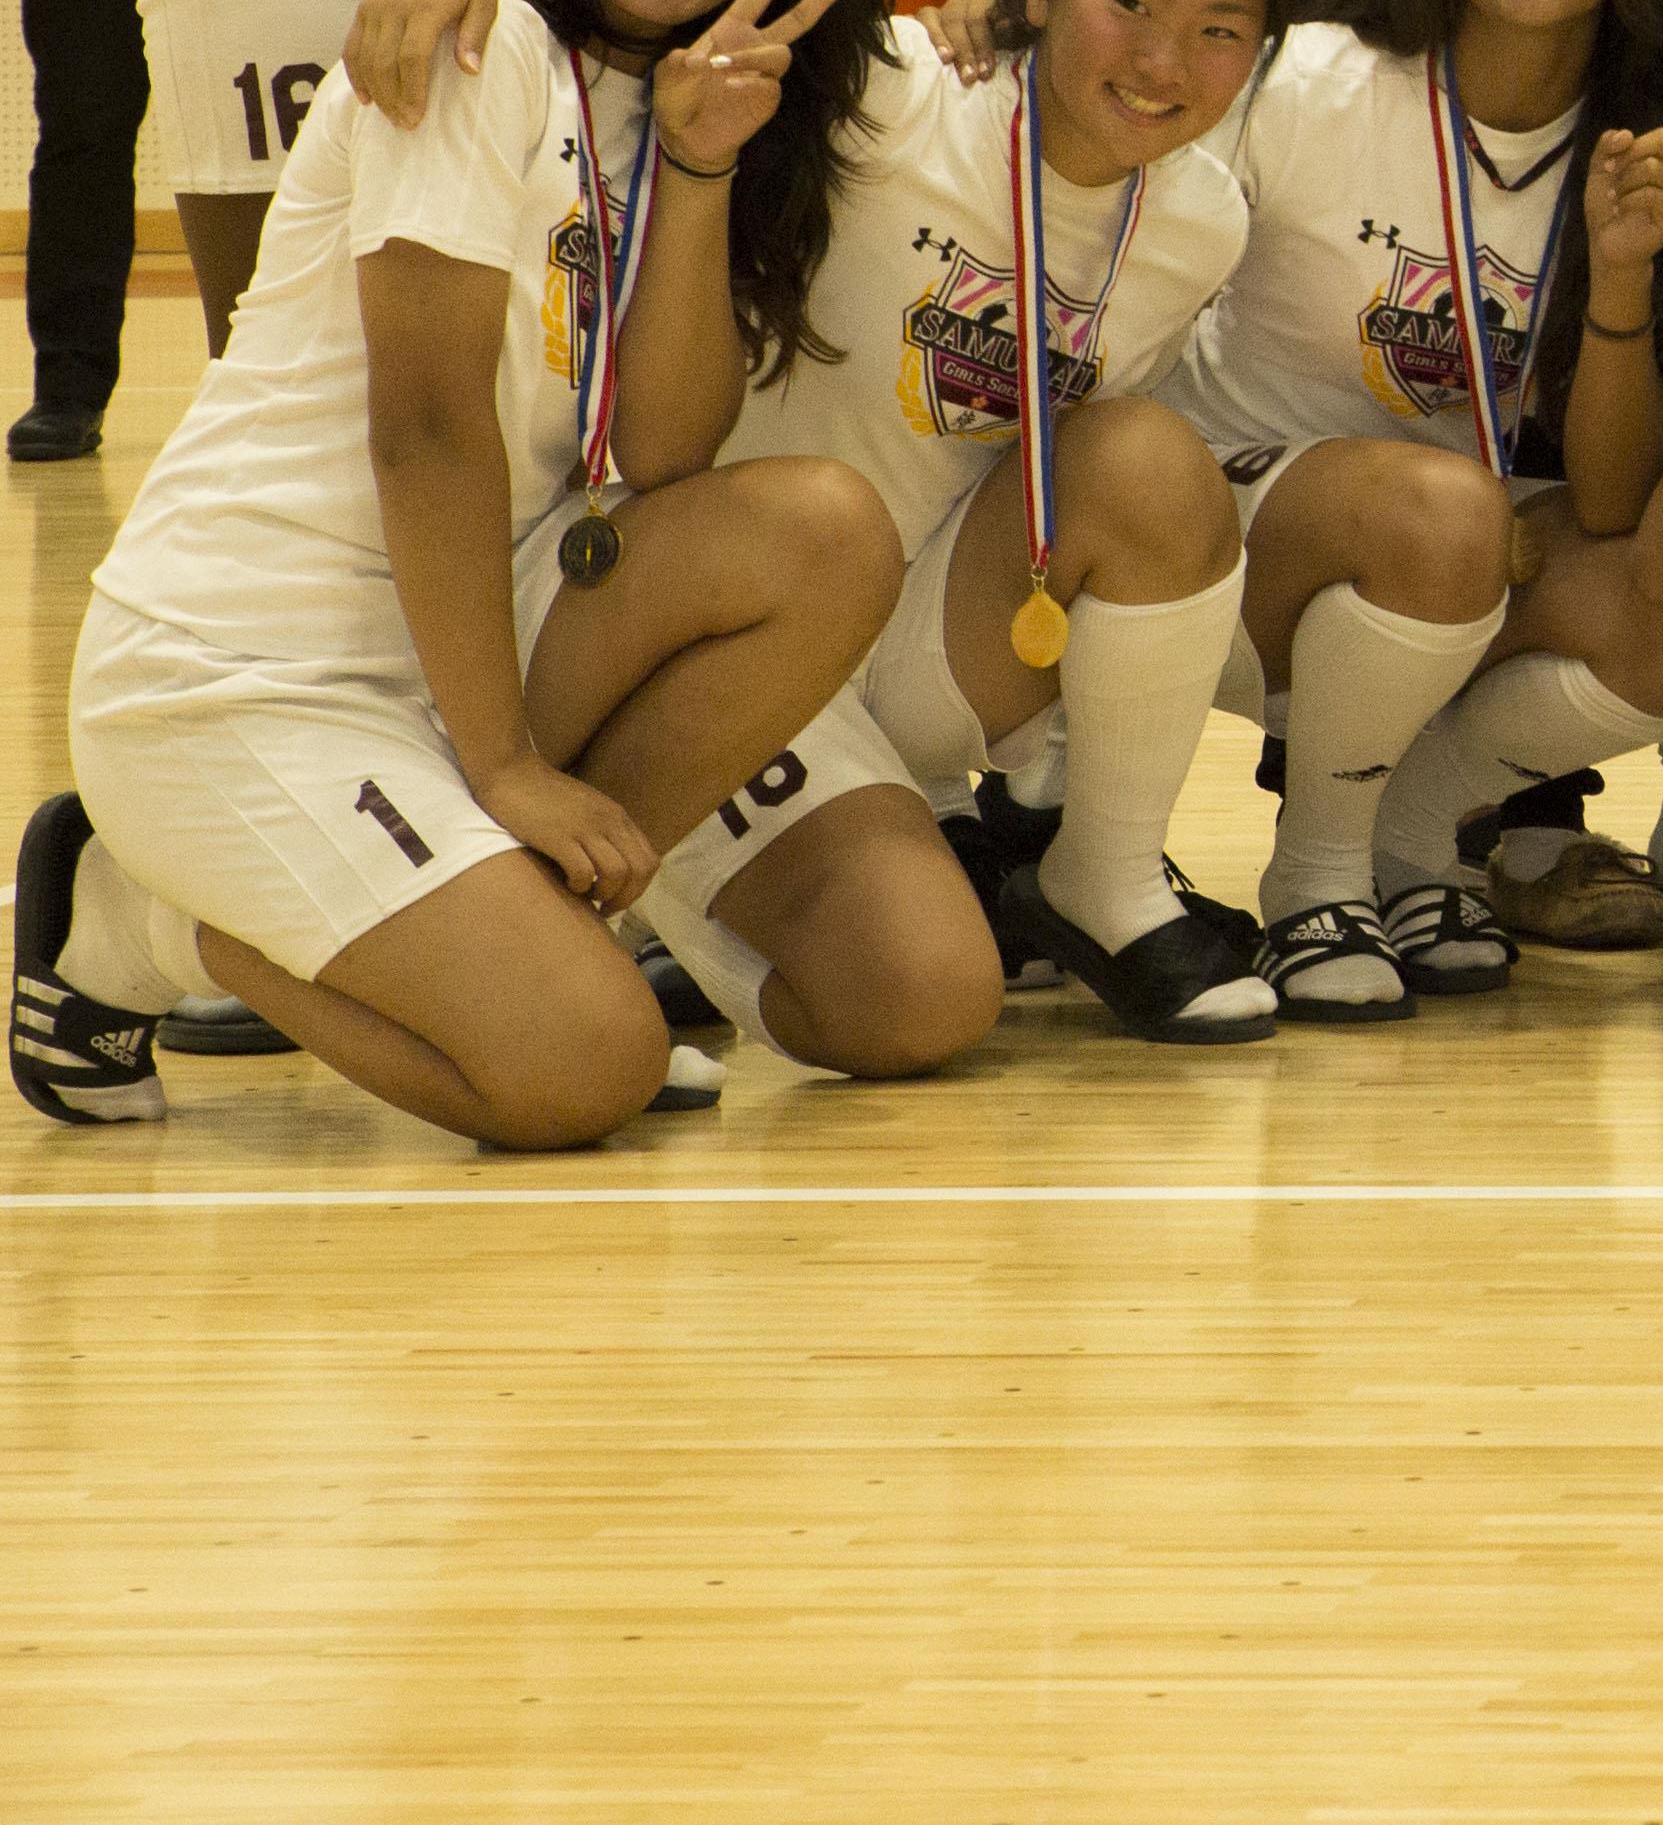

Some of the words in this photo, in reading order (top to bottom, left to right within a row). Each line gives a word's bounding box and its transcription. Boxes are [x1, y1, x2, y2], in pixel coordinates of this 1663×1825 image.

[916, 308, 1094, 396] SAMUAI
[1371, 310, 1524, 368] SAMR
[943, 361, 987, 387] GIRLS
[987, 377, 1018, 399] SOC
[353, 779, 435, 869] 1
[1287, 928, 1344, 942] adidas
